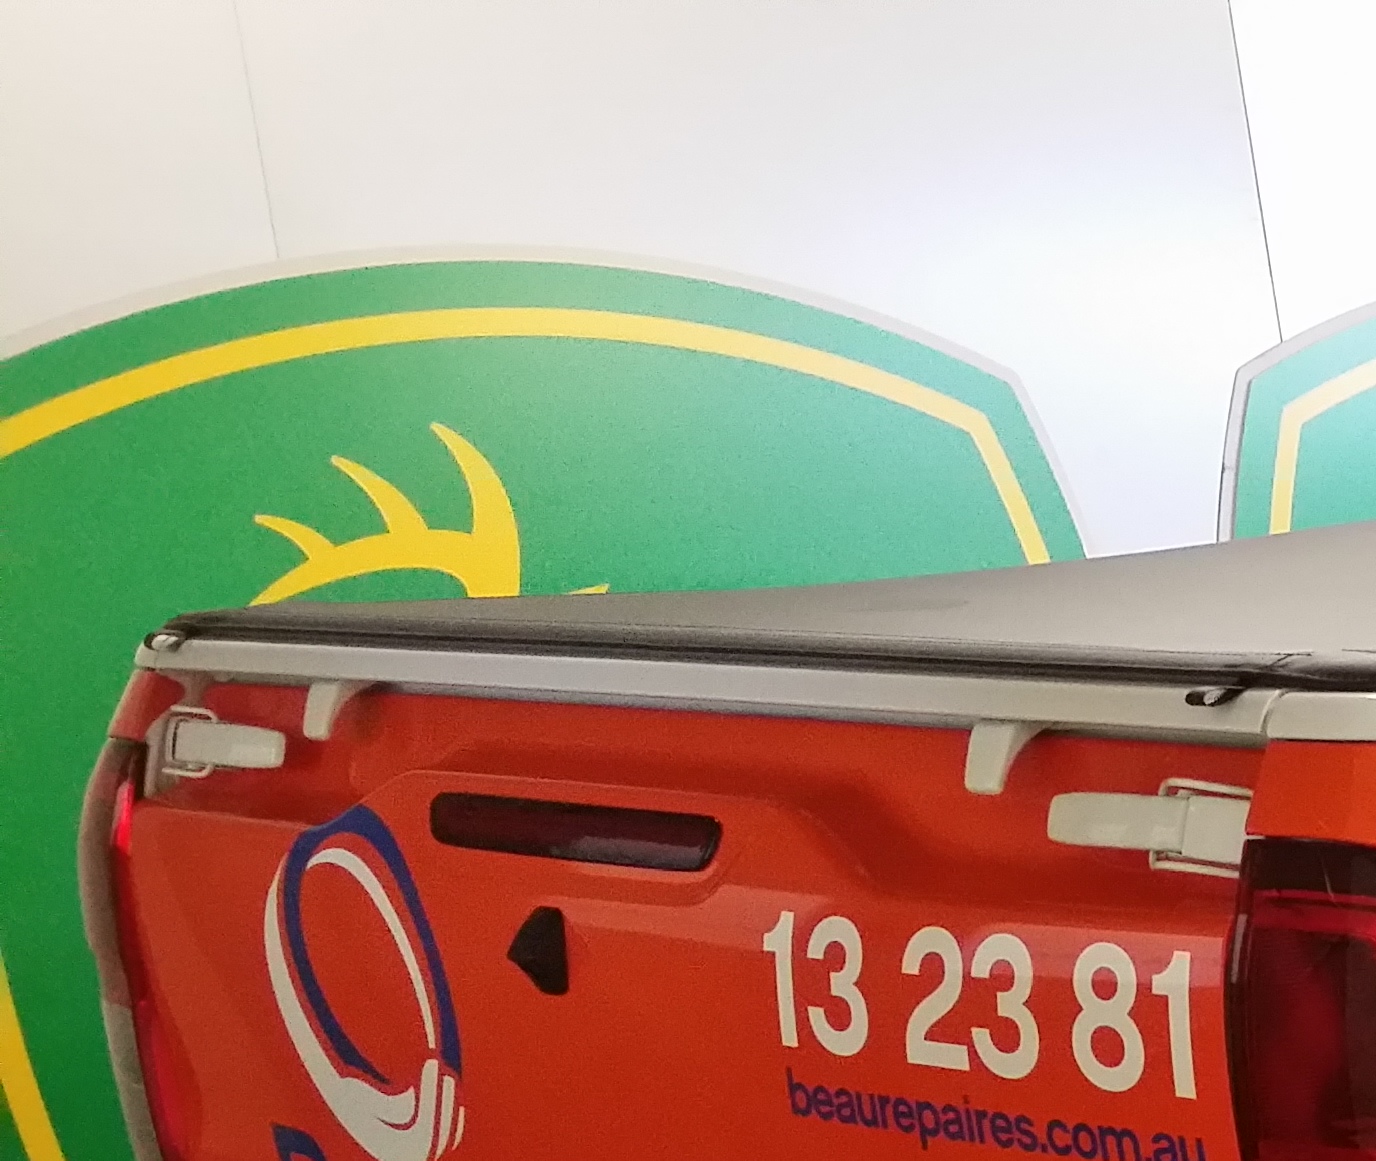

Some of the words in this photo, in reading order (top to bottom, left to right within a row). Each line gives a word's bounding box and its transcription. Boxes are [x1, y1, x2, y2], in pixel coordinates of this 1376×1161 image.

[763, 911, 869, 1056] 13
[901, 926, 1039, 1081] 23
[1071, 941, 1199, 1101] 81
